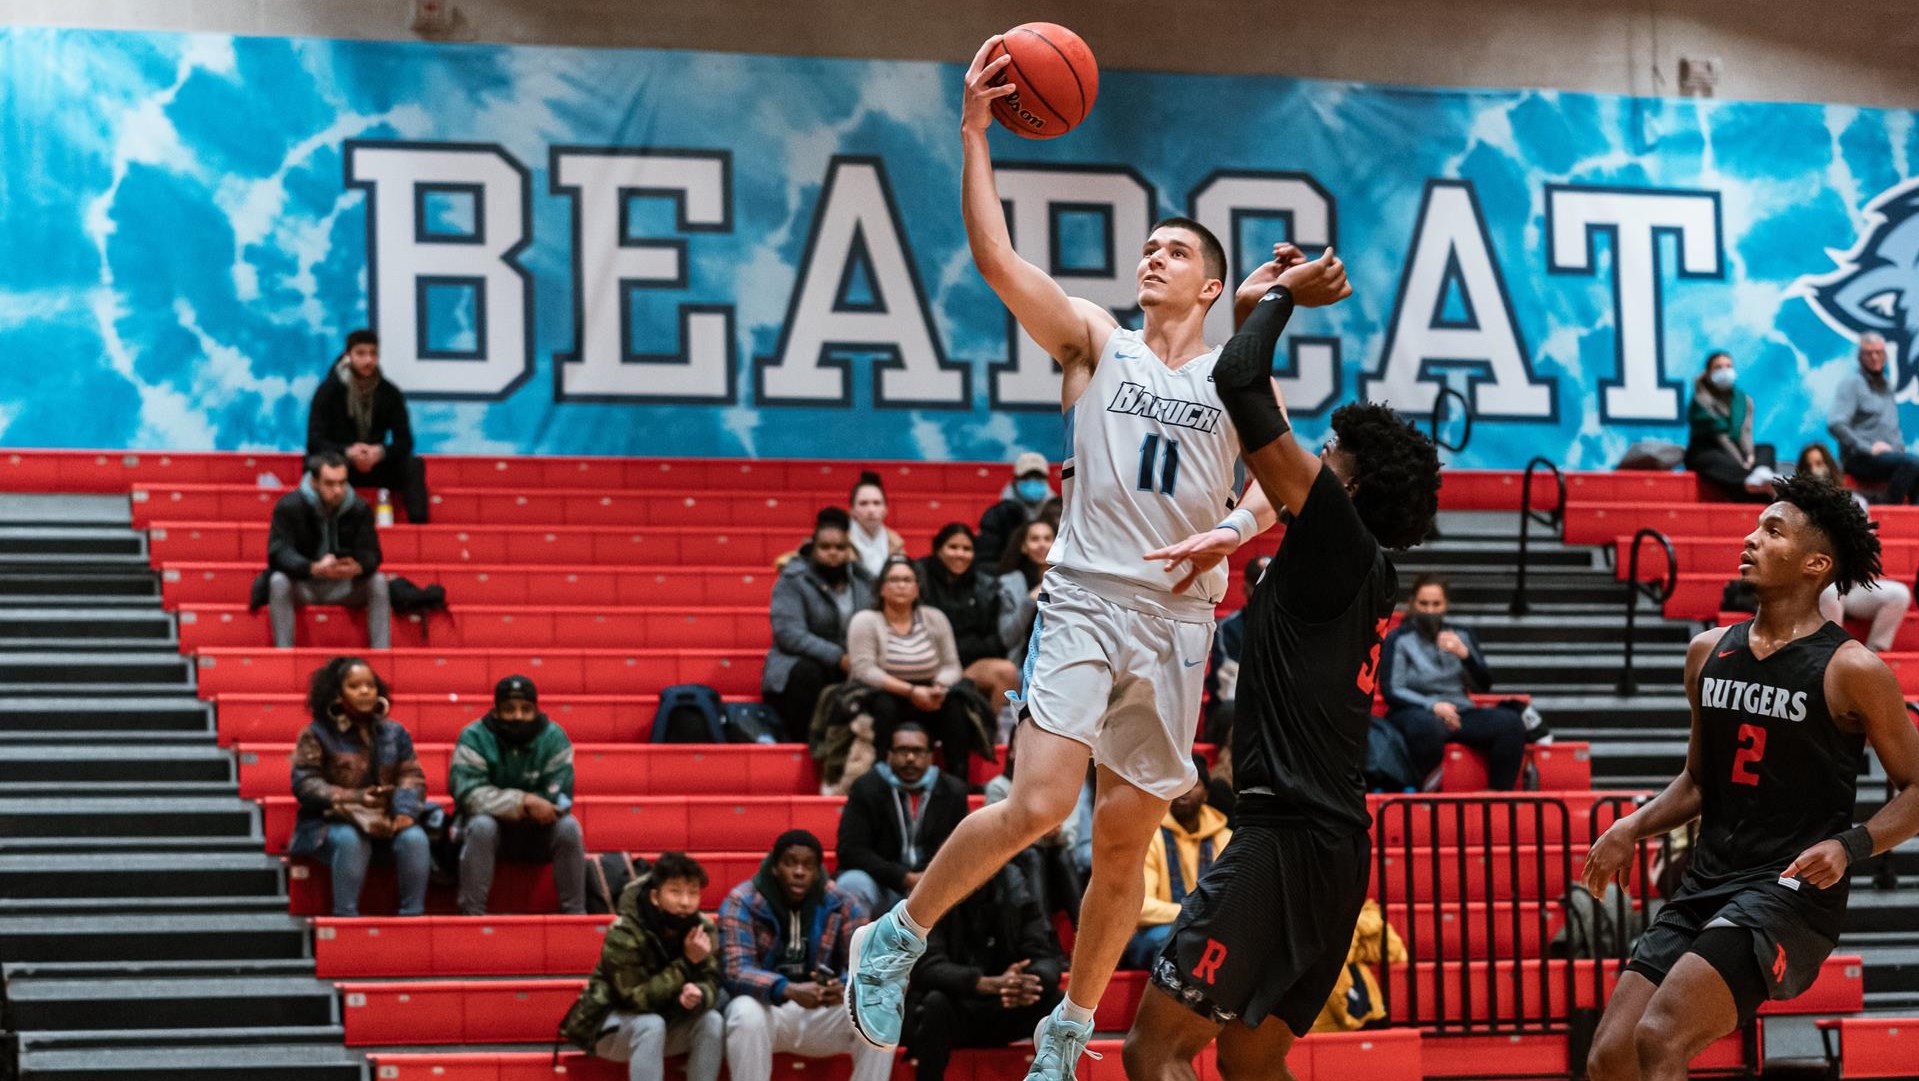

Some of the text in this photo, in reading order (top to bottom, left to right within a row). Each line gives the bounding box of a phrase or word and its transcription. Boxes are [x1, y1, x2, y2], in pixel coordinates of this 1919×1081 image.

[344, 140, 1723, 425] BEARCAT
[1107, 381, 1222, 433] BARUCH
[1137, 432, 1179, 497] 11
[1701, 677, 1808, 722] RUTGERS
[1731, 723, 1767, 786] 2
[1191, 938, 1228, 985] R
